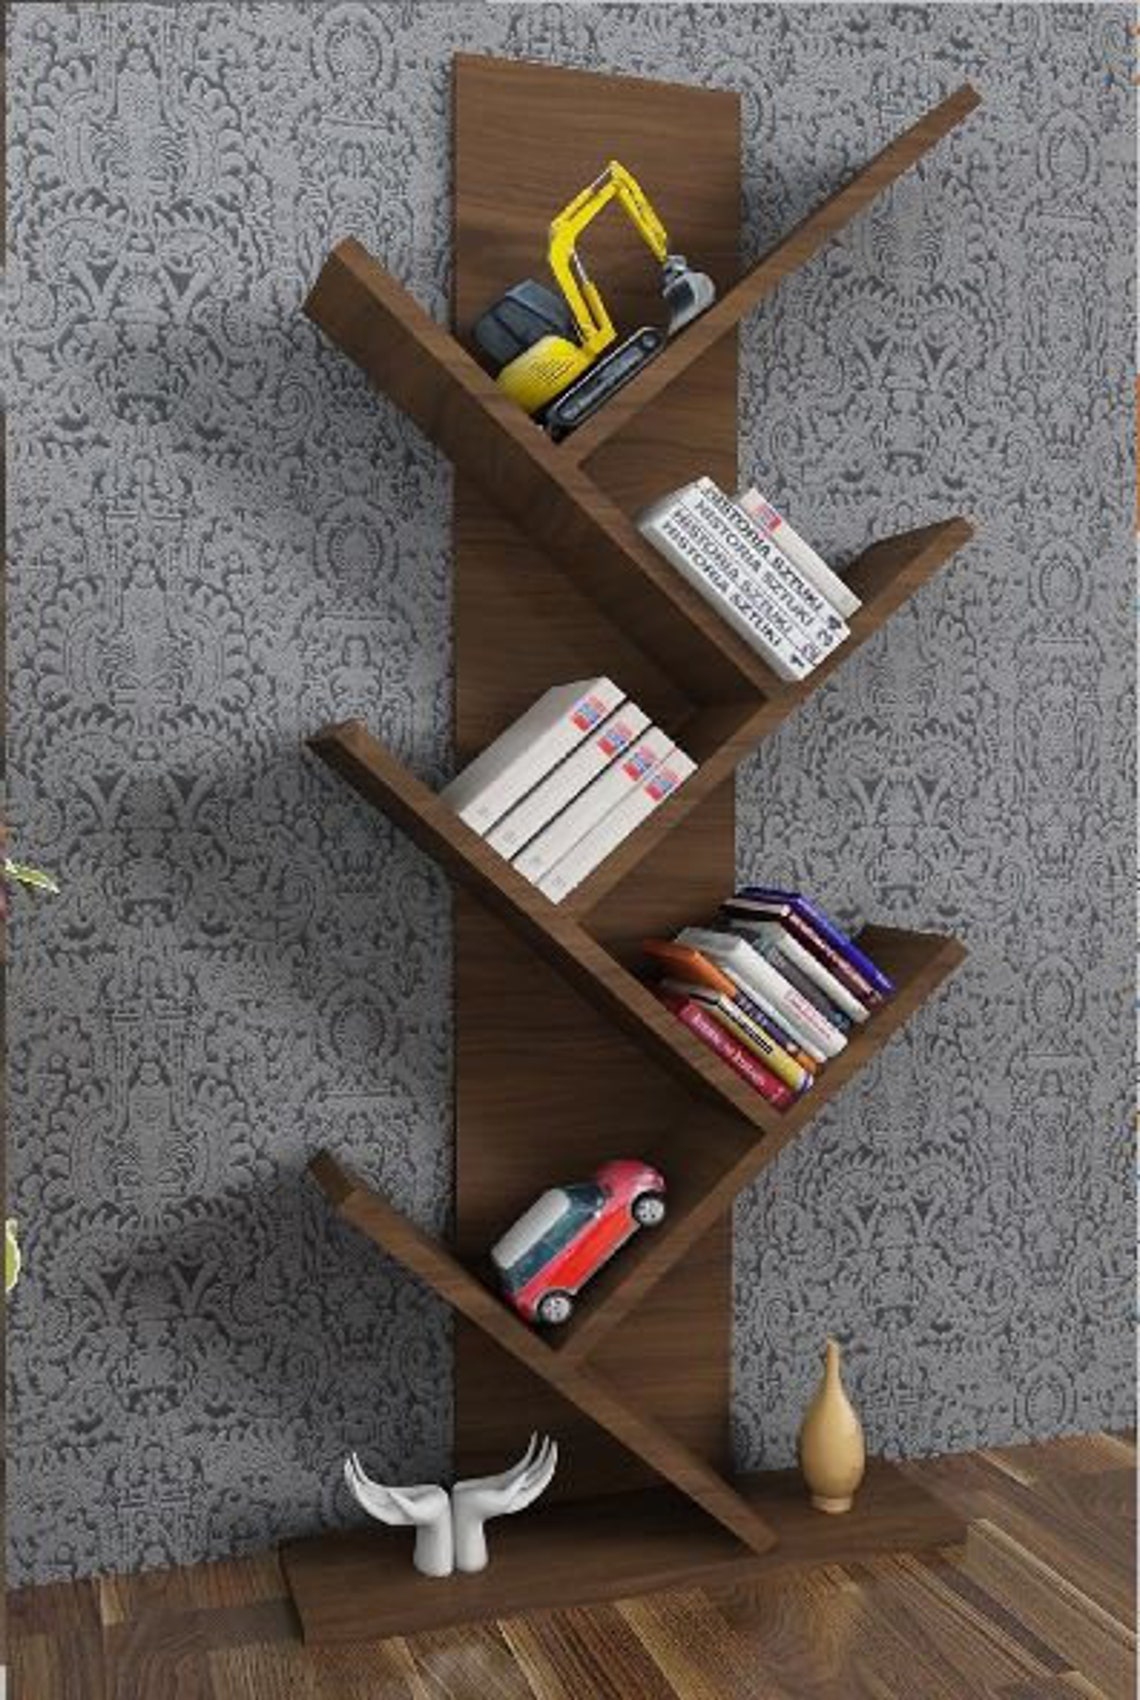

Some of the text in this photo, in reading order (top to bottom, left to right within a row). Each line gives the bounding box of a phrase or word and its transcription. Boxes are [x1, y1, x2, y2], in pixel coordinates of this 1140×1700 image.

[661, 520, 729, 594] HISTORIA
[729, 592, 782, 648] SZTUKI
[673, 509, 739, 581] HISTORIA
[742, 578, 794, 635] SZTUKI
[693, 500, 834, 647] HISTORIA SZTUKI 3
